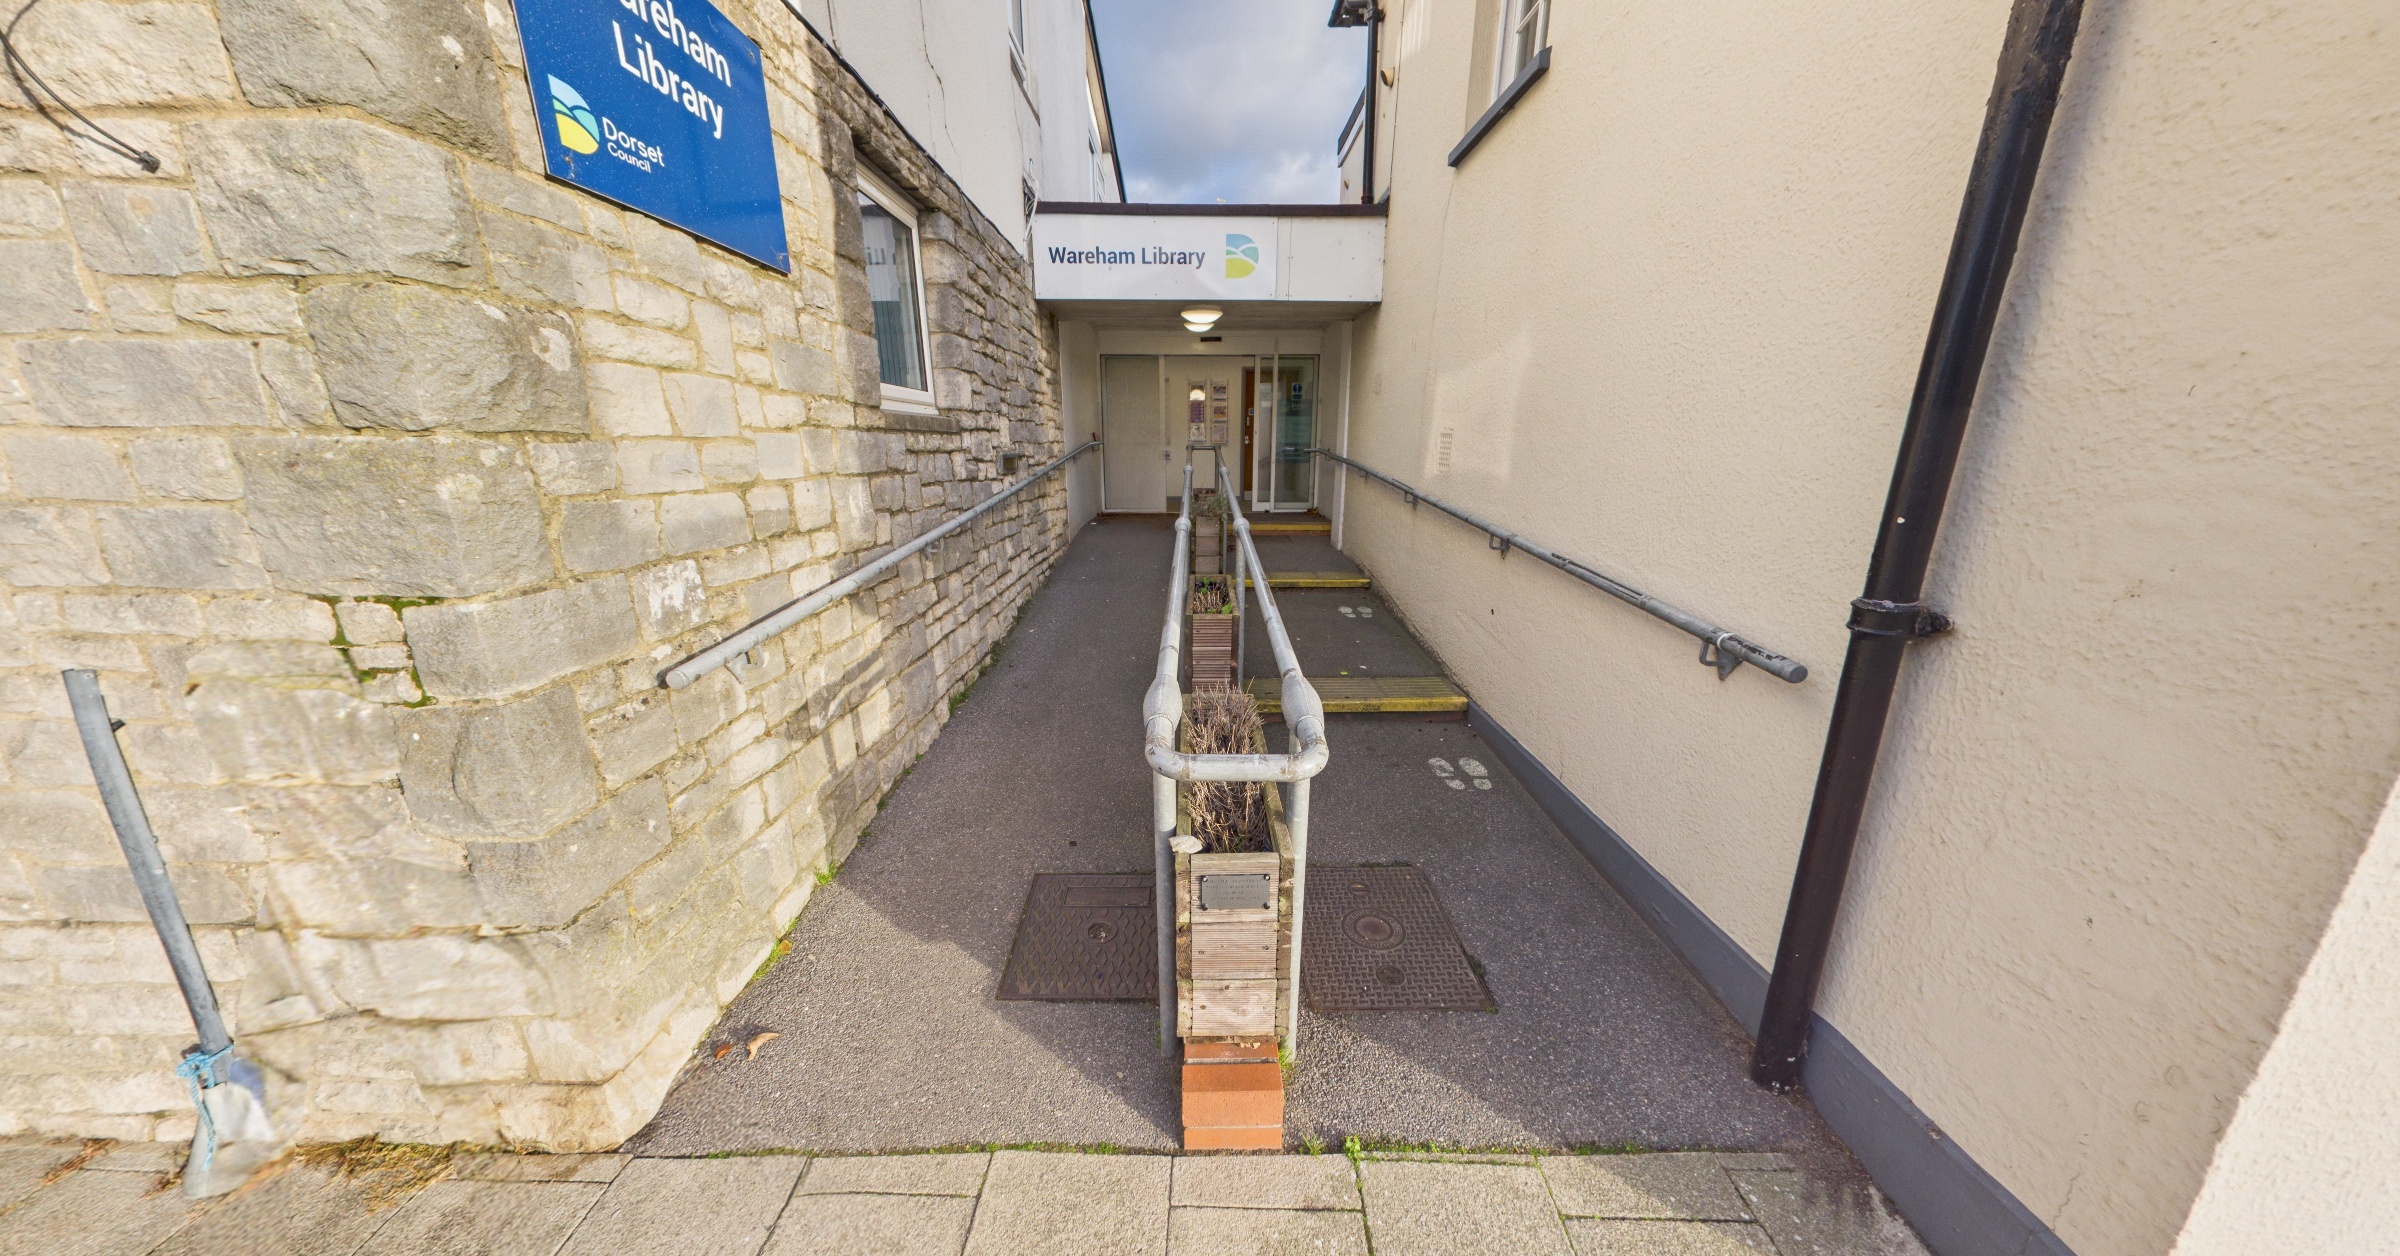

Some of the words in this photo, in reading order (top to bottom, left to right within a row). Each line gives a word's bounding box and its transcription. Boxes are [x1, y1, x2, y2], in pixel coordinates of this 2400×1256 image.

[612, 19, 723, 139] Library
[602, 116, 665, 168] Dorset
[607, 141, 651, 174] Council
[1048, 245, 1136, 265] Wareham
[1141, 246, 1206, 270] Library
